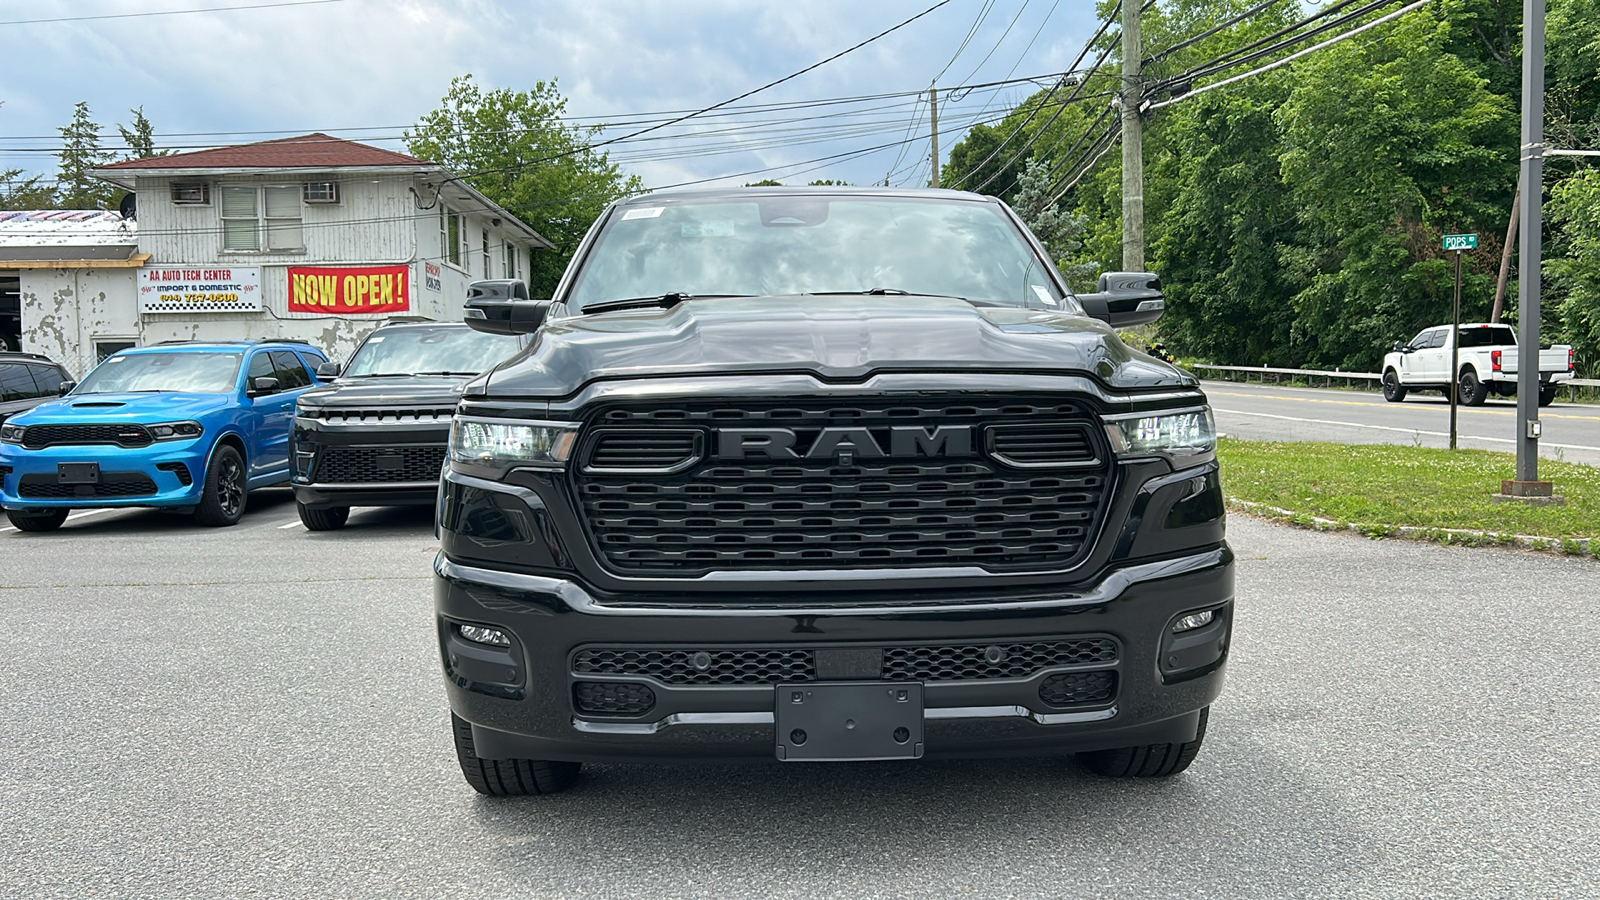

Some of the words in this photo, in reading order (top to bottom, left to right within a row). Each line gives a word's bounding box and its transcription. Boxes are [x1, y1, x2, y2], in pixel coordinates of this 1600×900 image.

[1445, 237, 1467, 247] POPS
[149, 270, 160, 281] AA
[162, 270, 181, 281] AUTO
[182, 269, 201, 281] TECH
[203, 269, 232, 281] CENTER
[292, 273, 338, 306] NOW
[718, 425, 972, 459] RAM
